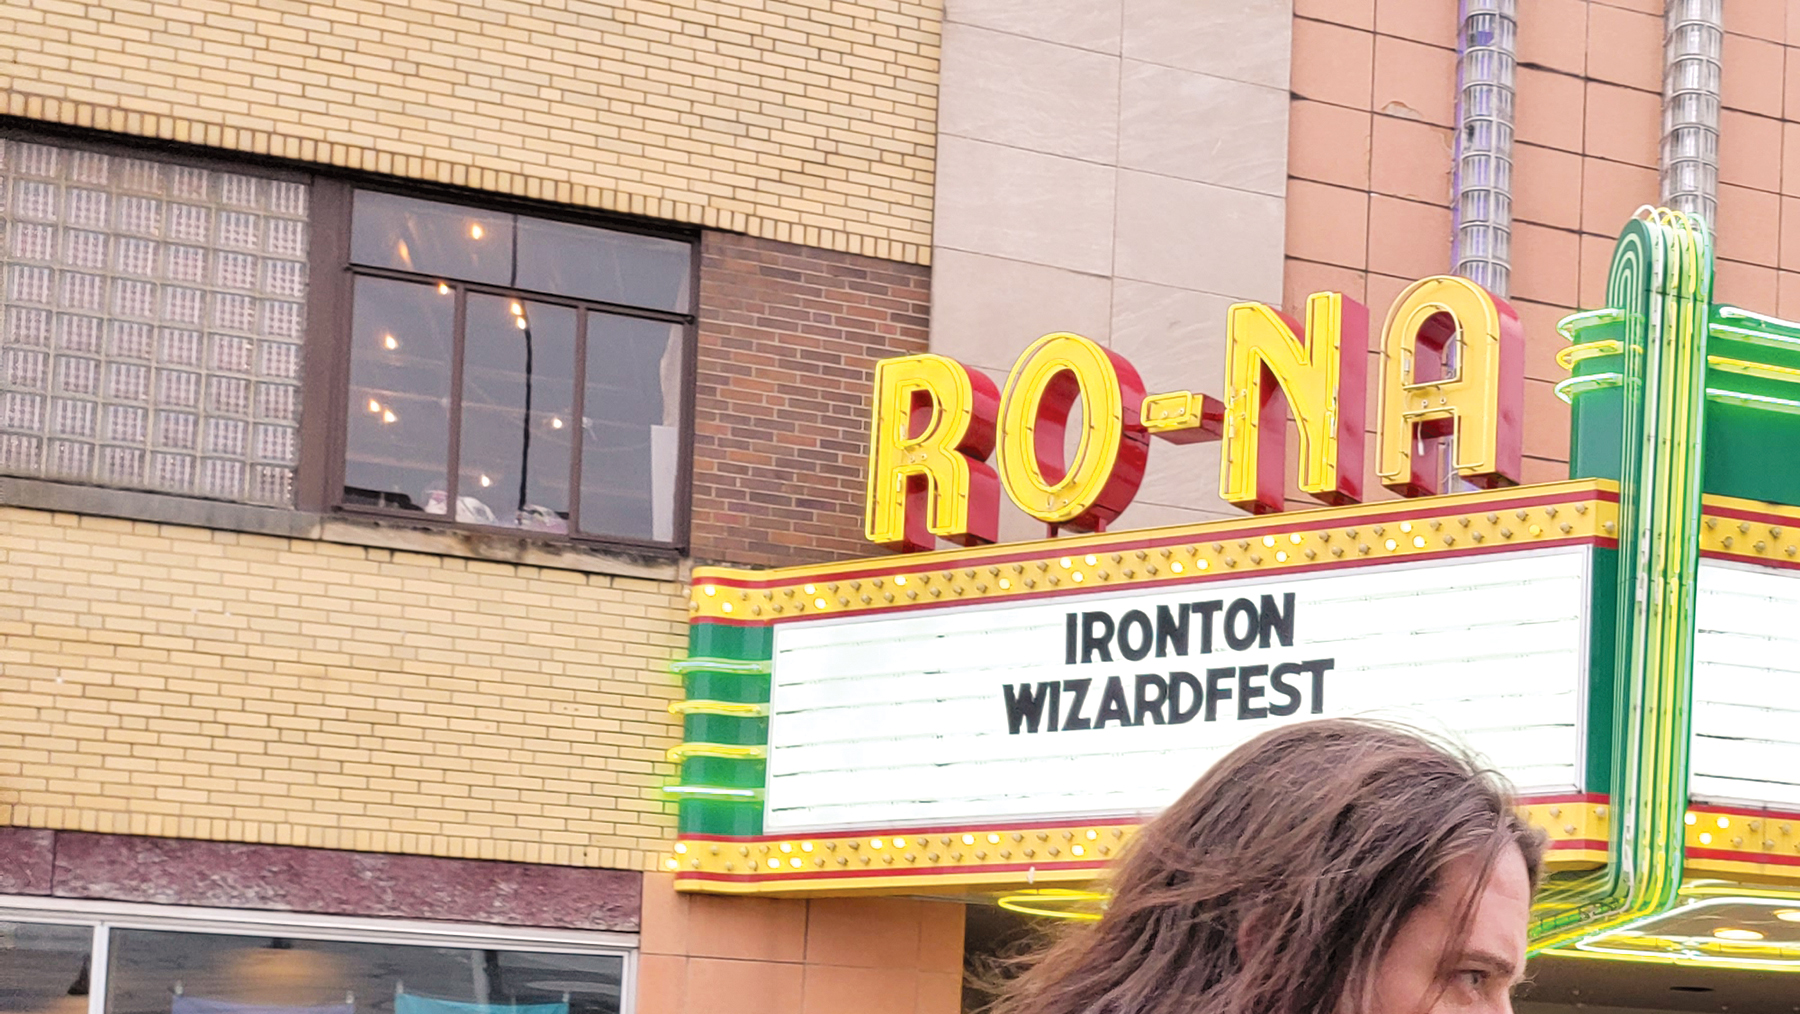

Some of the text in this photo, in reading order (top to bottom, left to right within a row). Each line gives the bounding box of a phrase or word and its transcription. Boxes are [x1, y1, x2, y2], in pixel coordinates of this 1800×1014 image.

[864, 275, 1518, 550] RO-NA
[1065, 592, 1296, 665] IRONTON
[1002, 658, 1335, 735] WIZARDFEST
